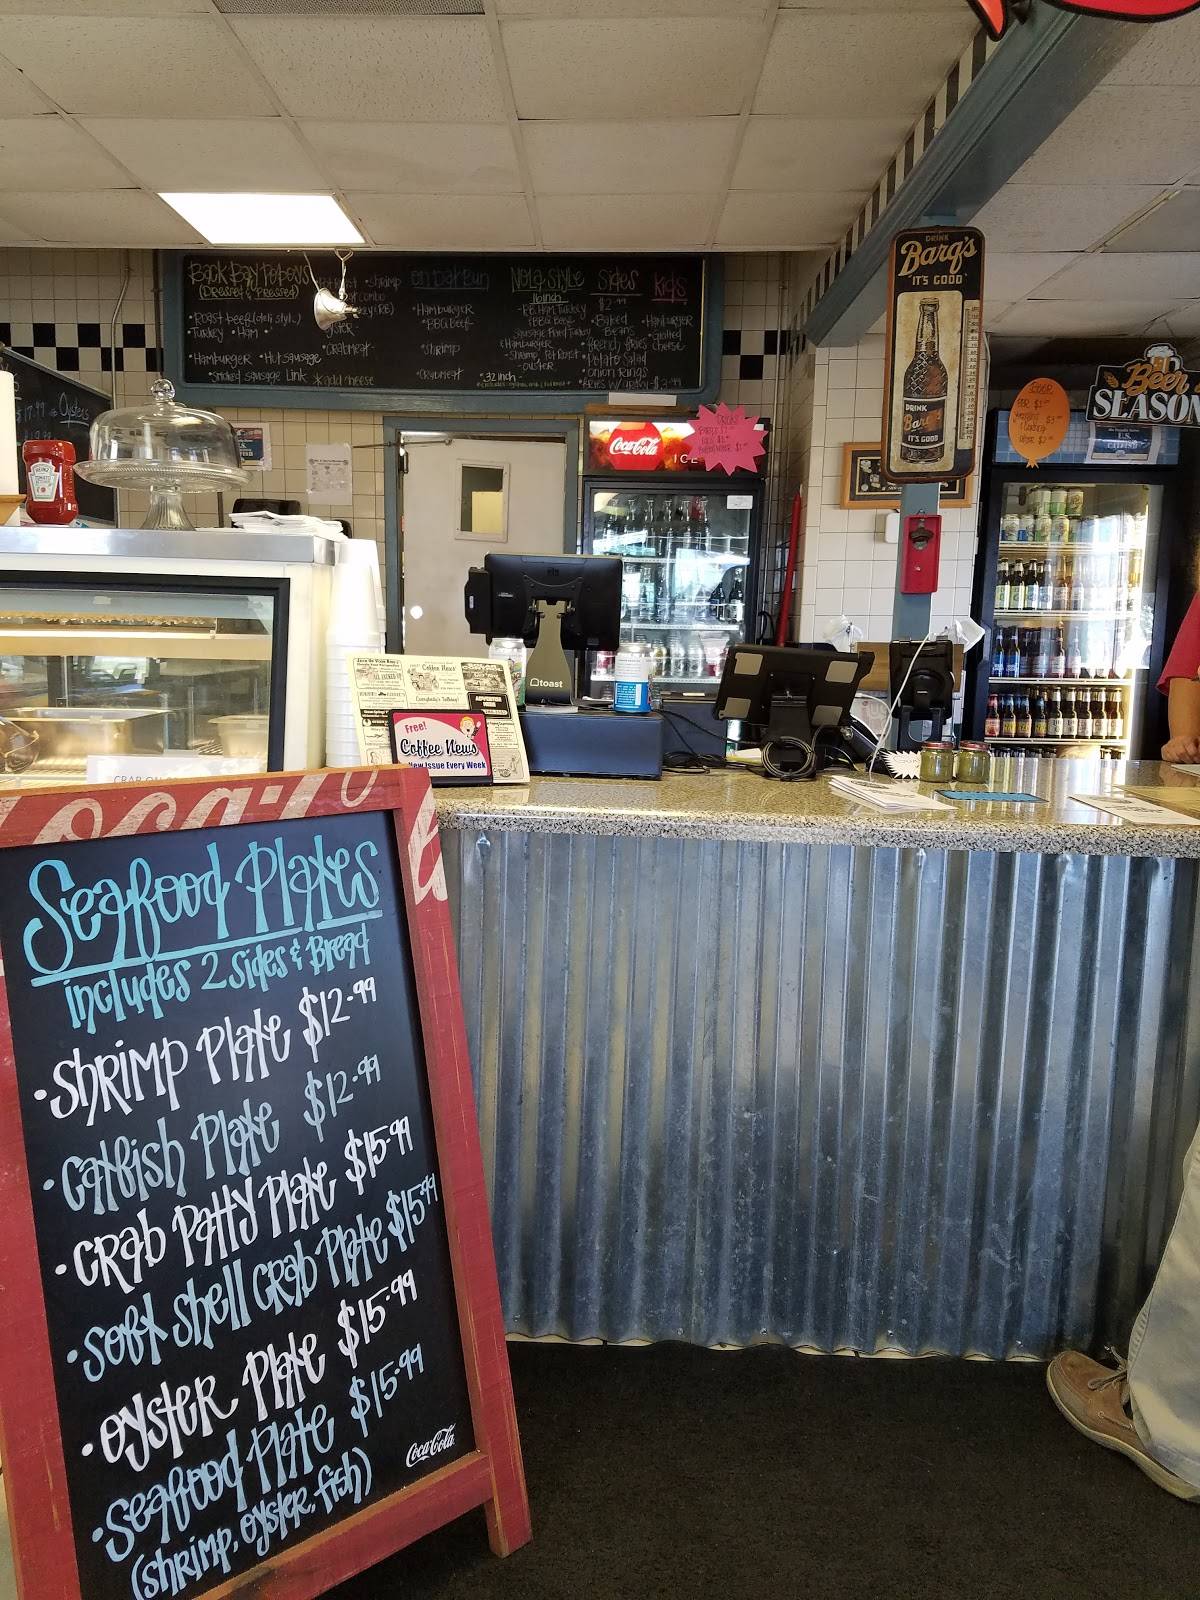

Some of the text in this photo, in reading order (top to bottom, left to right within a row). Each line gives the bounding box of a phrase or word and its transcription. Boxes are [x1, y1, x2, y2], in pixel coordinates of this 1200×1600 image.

[188, 260, 229, 285] Back
[230, 261, 259, 291] Bay
[898, 236, 977, 277] Barq's
[933, 274, 963, 285] GOOD
[1121, 363, 1190, 397] Beer
[609, 436, 662, 456] Coca-Cola
[539, 679, 564, 688] toast
[400, 738, 478, 757] Coffee News
[404, 721, 428, 734] Free!
[446, 761, 465, 770] Every
[465, 761, 487, 769] Week
[23, 834, 380, 975] Seafood Plates
[201, 952, 228, 991] 2
[306, 922, 372, 977] Bread
[195, 1007, 292, 1086] Plate
[190, 1097, 280, 1180] Plate
[256, 1155, 337, 1239] Plate
[314, 1212, 389, 1289] Plate
[241, 1331, 327, 1422] Plate
[246, 1403, 336, 1495] Plate
[404, 1422, 457, 1468] Coca-Cola
